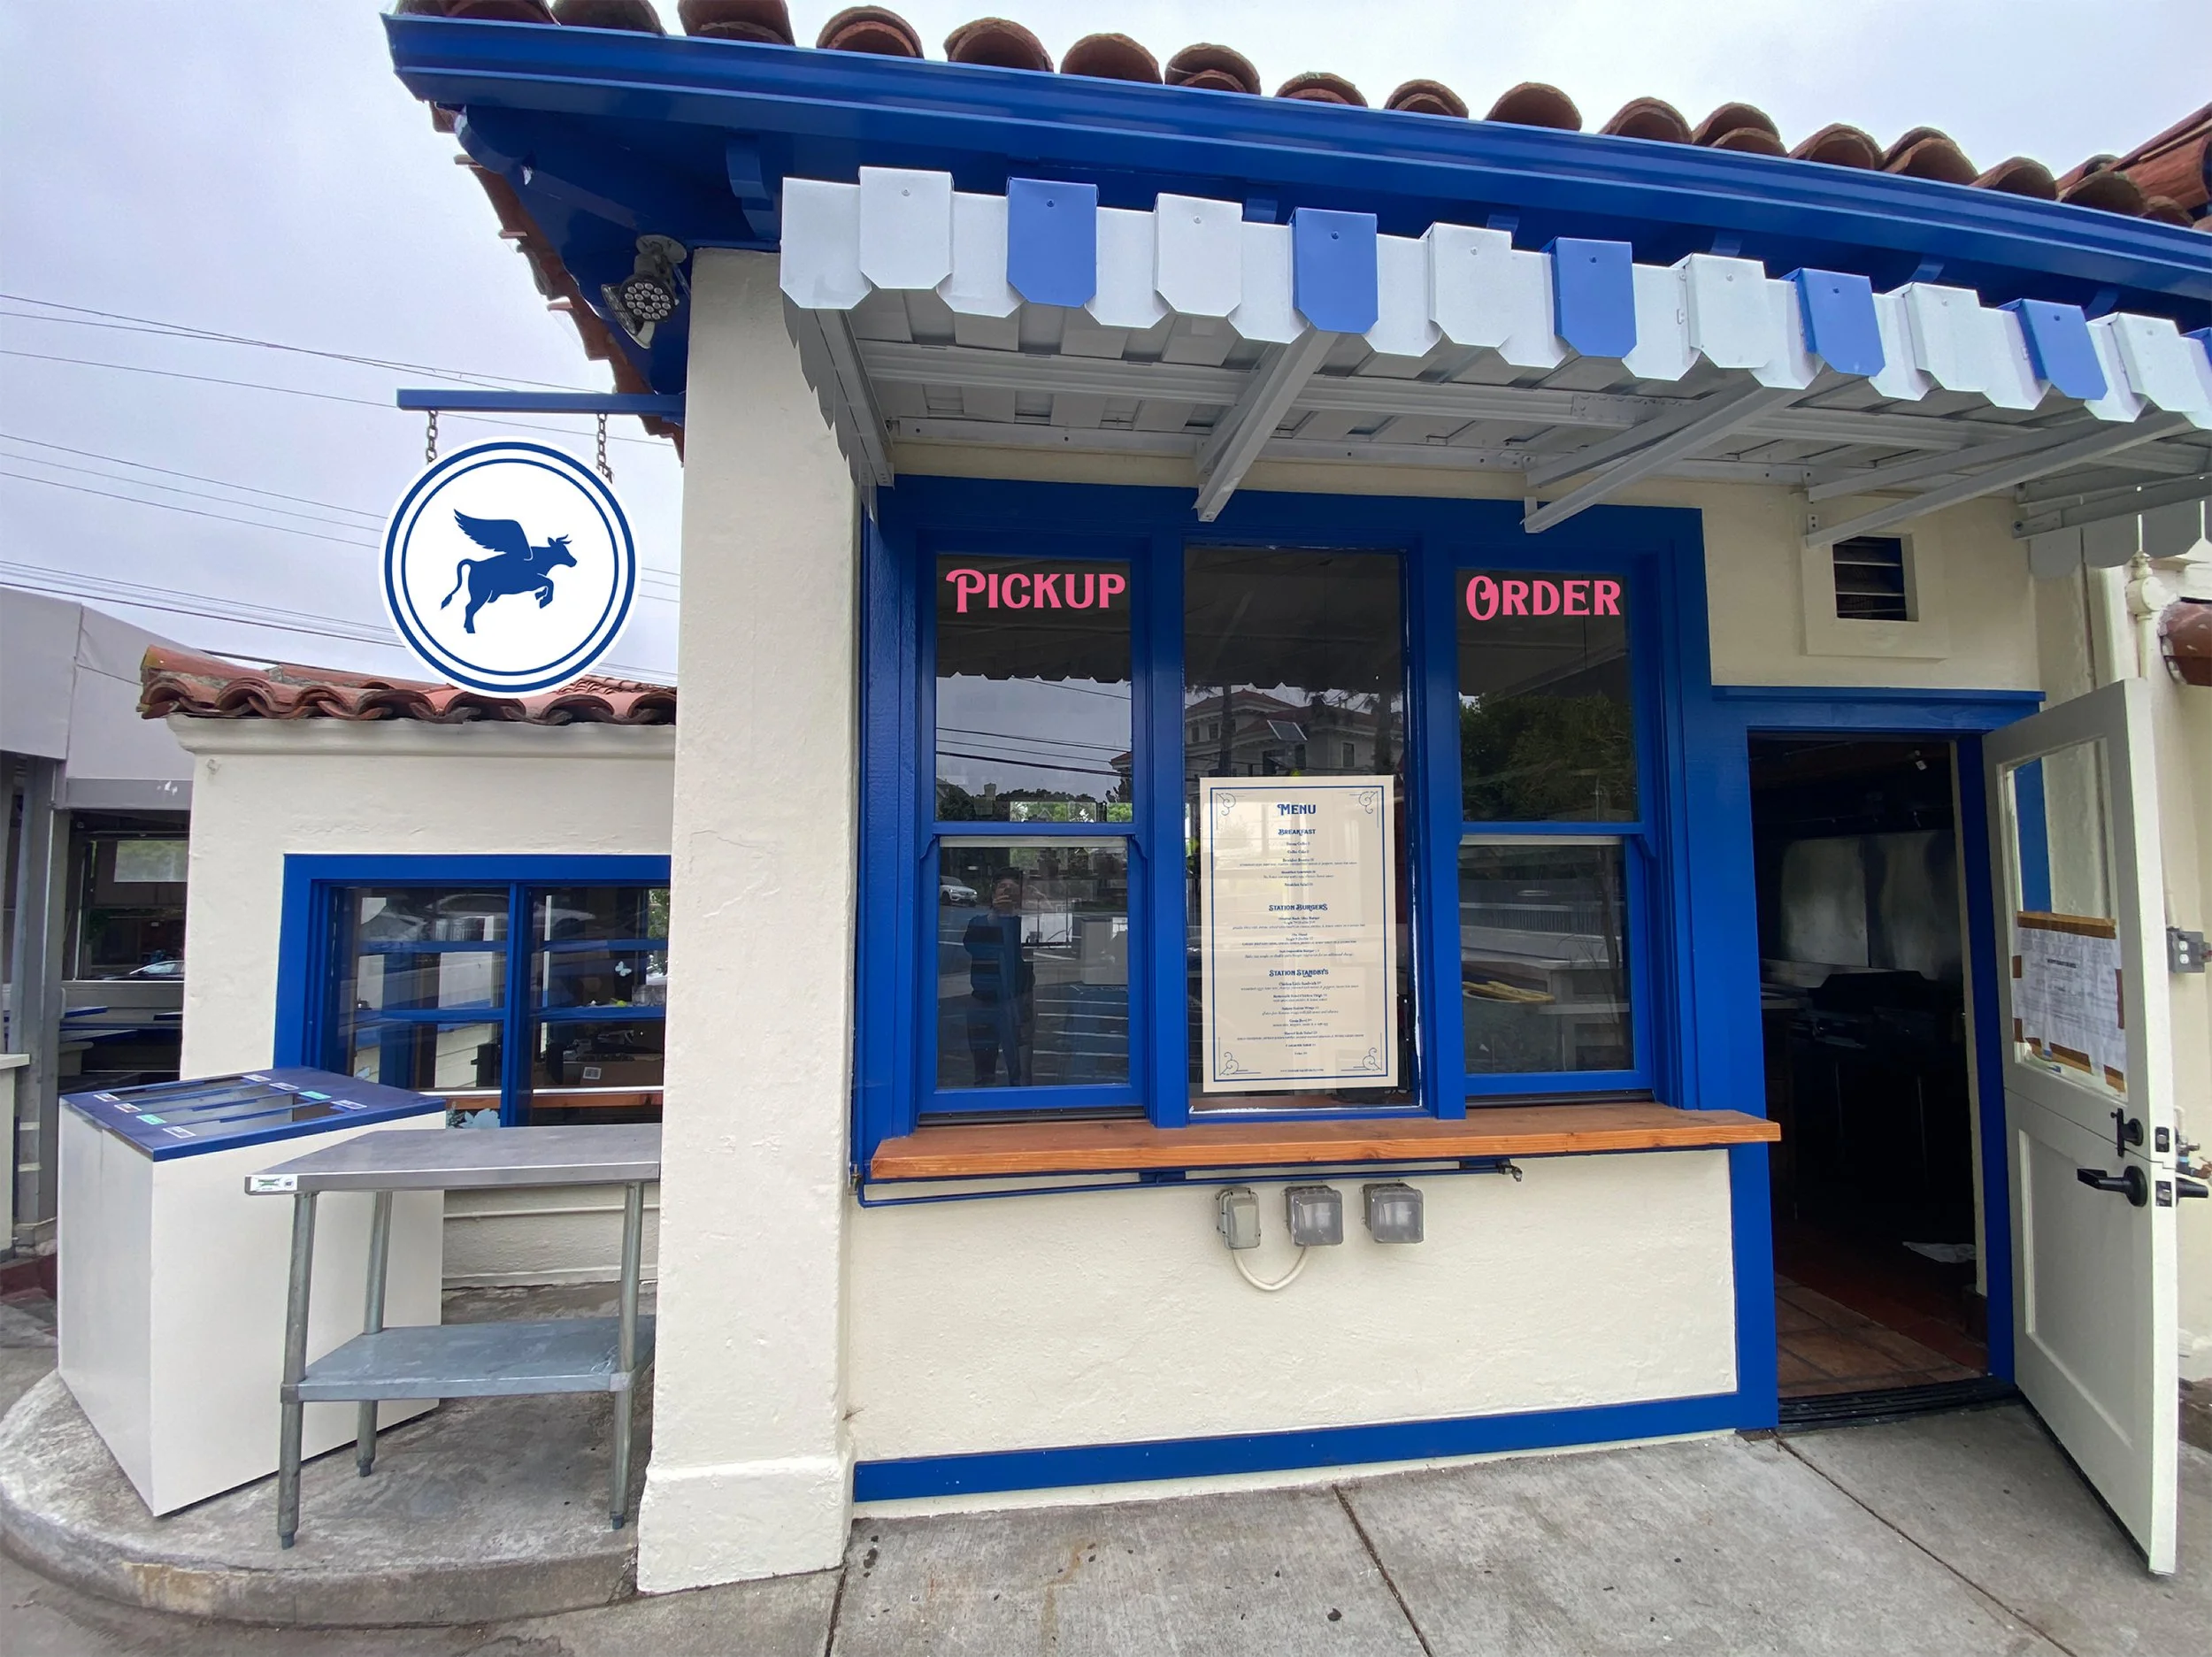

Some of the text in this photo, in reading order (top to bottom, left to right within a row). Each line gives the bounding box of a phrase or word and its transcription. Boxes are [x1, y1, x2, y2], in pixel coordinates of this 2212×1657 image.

[945, 569, 1125, 613] PICKUP
[1465, 575, 1621, 621] ORDER
[1277, 803, 1317, 816] MENU
[1295, 903, 1328, 912] BURGERS
